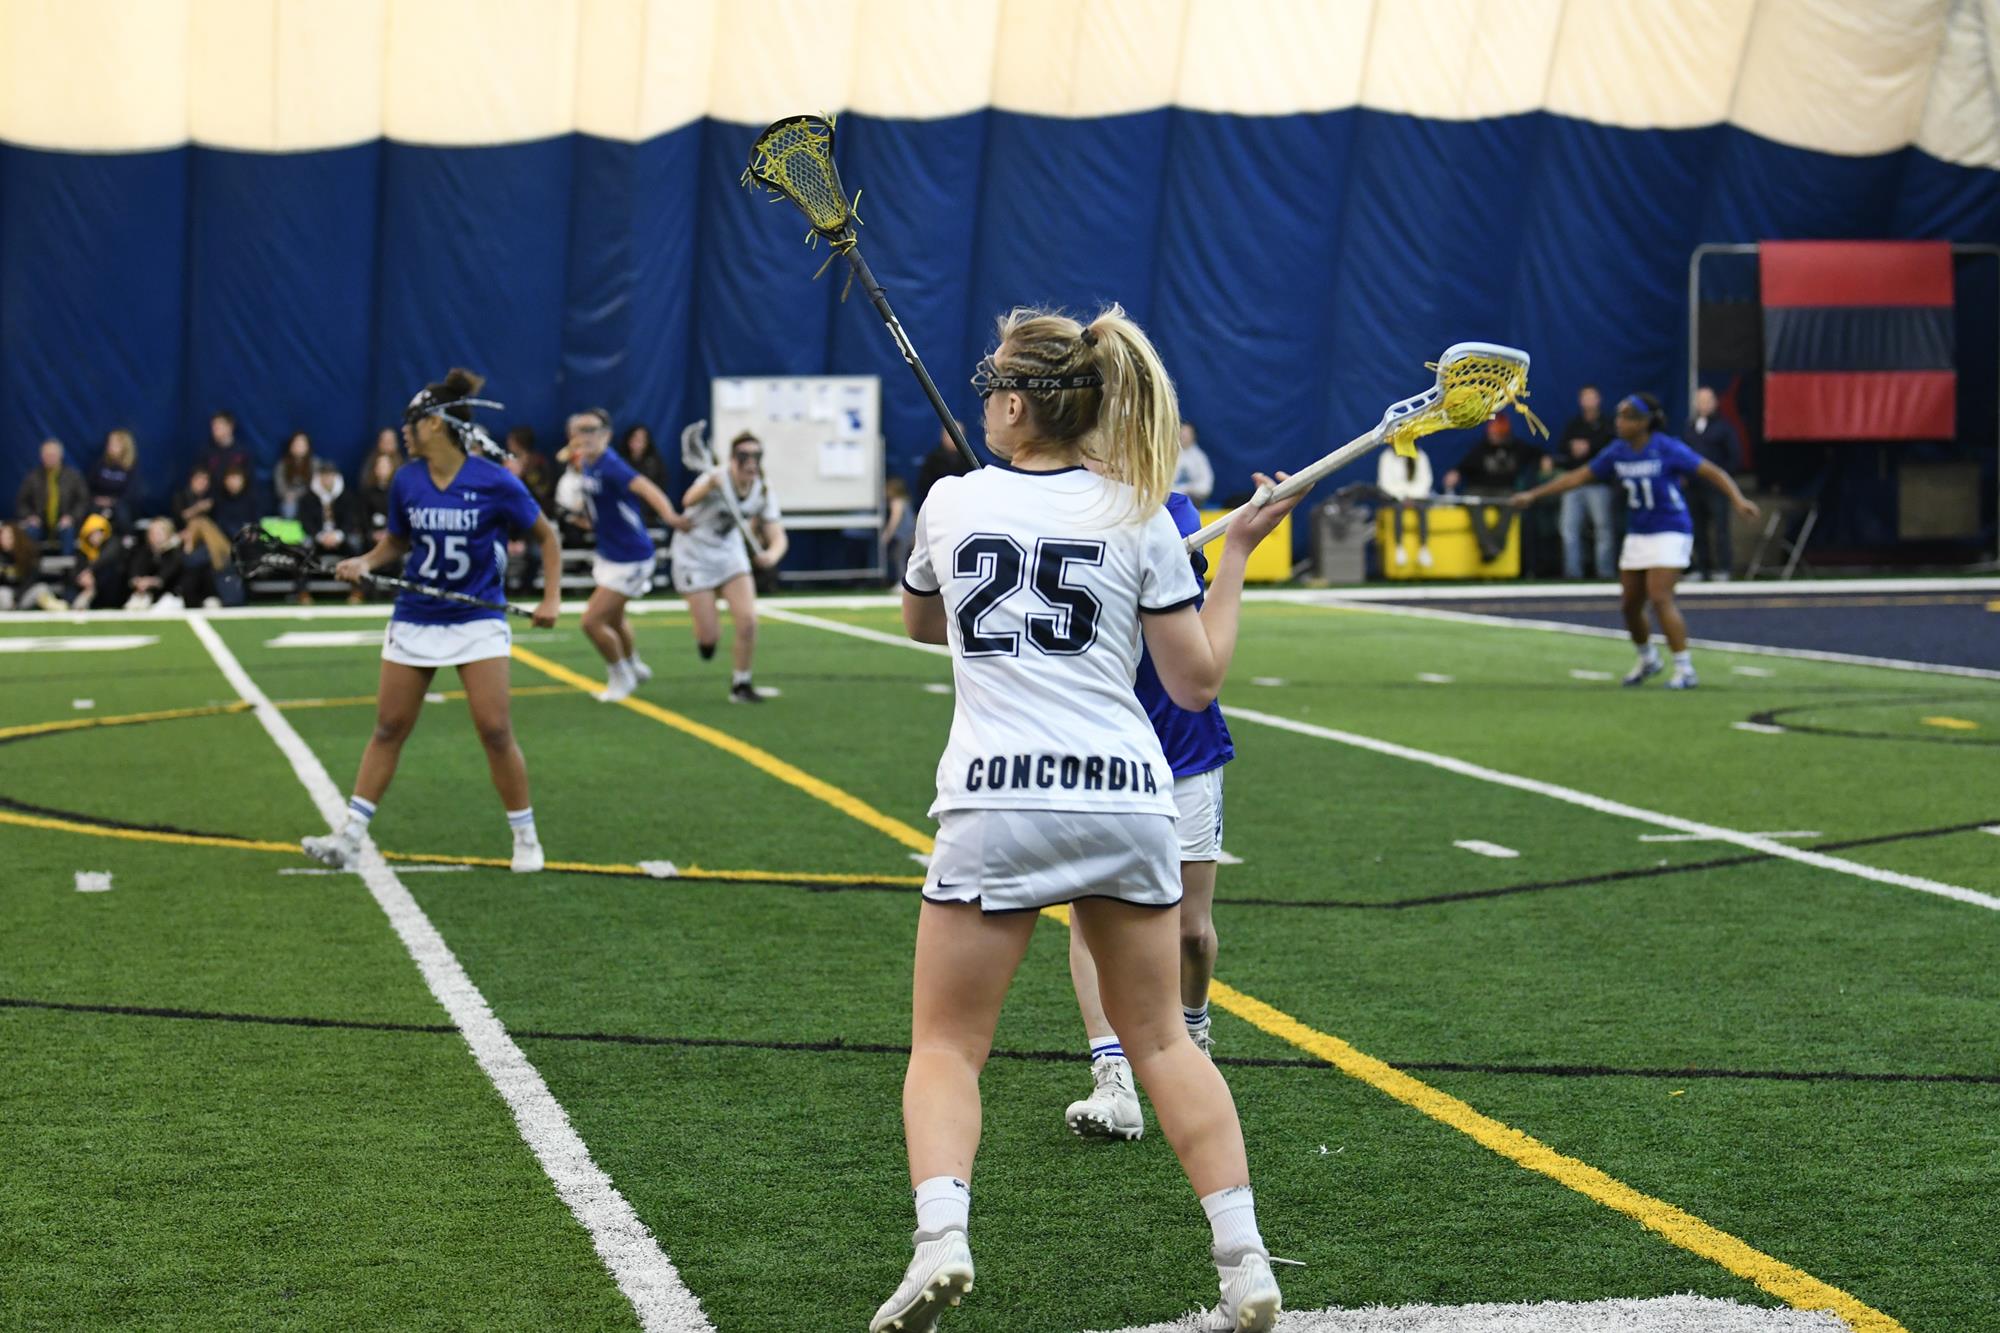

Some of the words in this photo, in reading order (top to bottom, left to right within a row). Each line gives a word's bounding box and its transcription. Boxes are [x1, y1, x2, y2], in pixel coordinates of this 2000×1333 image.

[991, 378, 1018, 388] STX
[1027, 378, 1062, 388] STX
[418, 534, 471, 580] 25
[953, 532, 1106, 658] 25
[966, 755, 1157, 795] CONCORDIA
